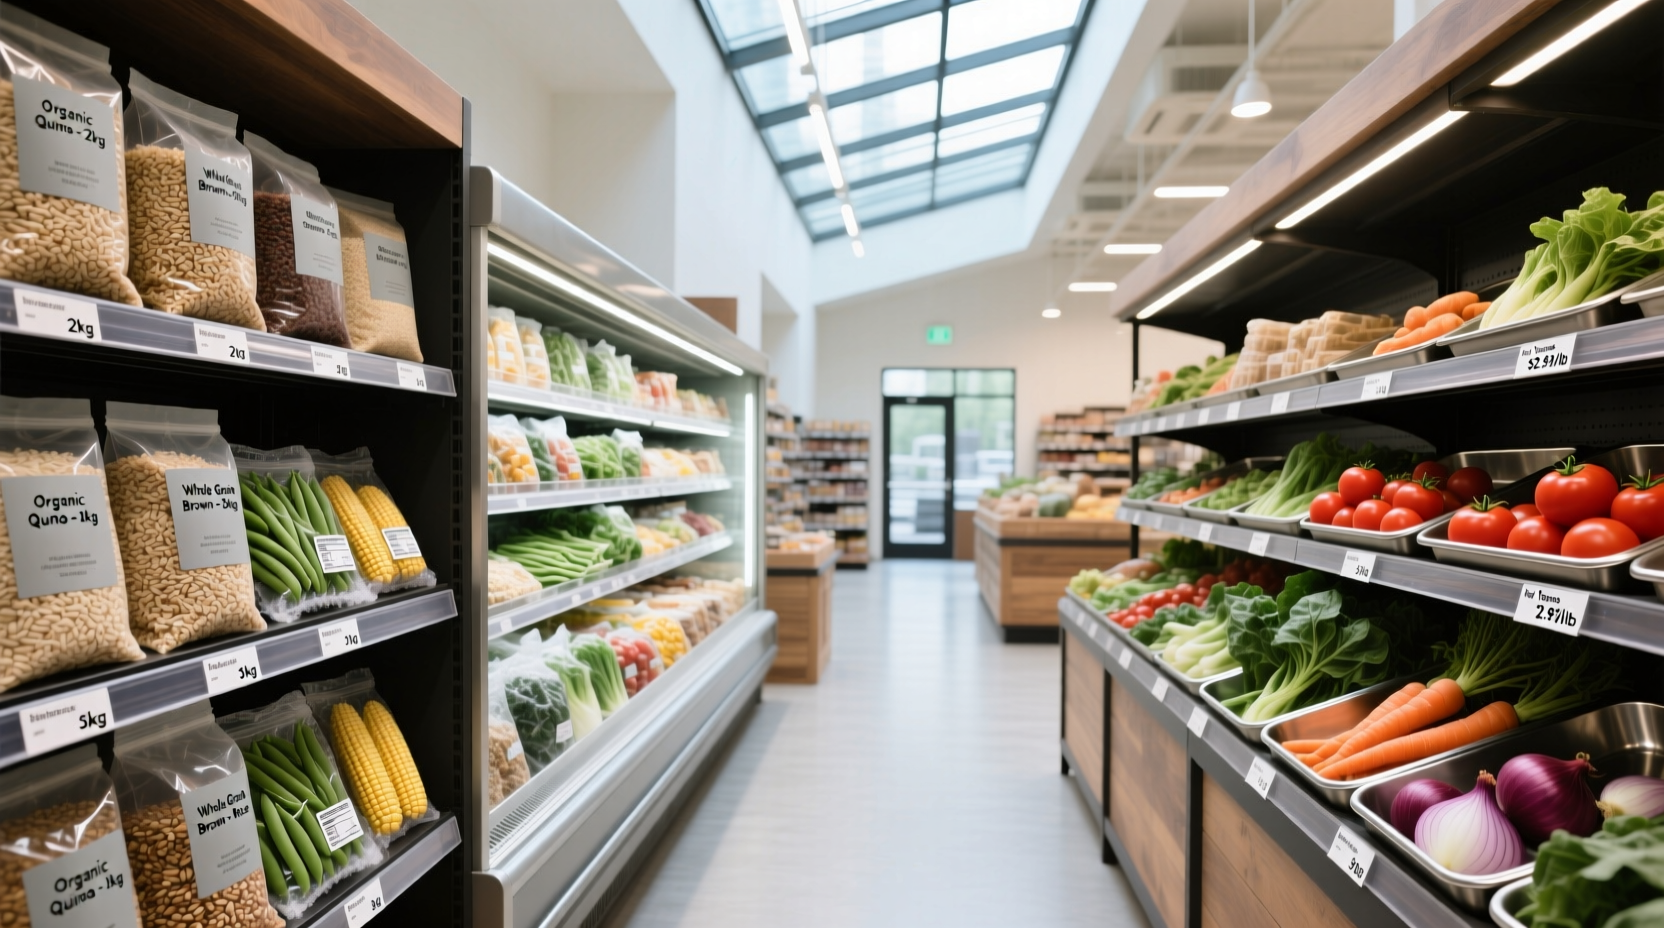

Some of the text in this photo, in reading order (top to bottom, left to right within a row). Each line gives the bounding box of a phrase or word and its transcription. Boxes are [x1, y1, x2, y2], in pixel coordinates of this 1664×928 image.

[41, 99, 94, 126] Organic
[83, 128, 106, 150] 2kg
[67, 317, 94, 339] 2kg
[33, 491, 86, 511] Organic
[79, 509, 99, 527] 1kg
[79, 710, 107, 730] 5kg
[54, 859, 109, 893] Organic
[105, 873, 124, 890] 1kg
